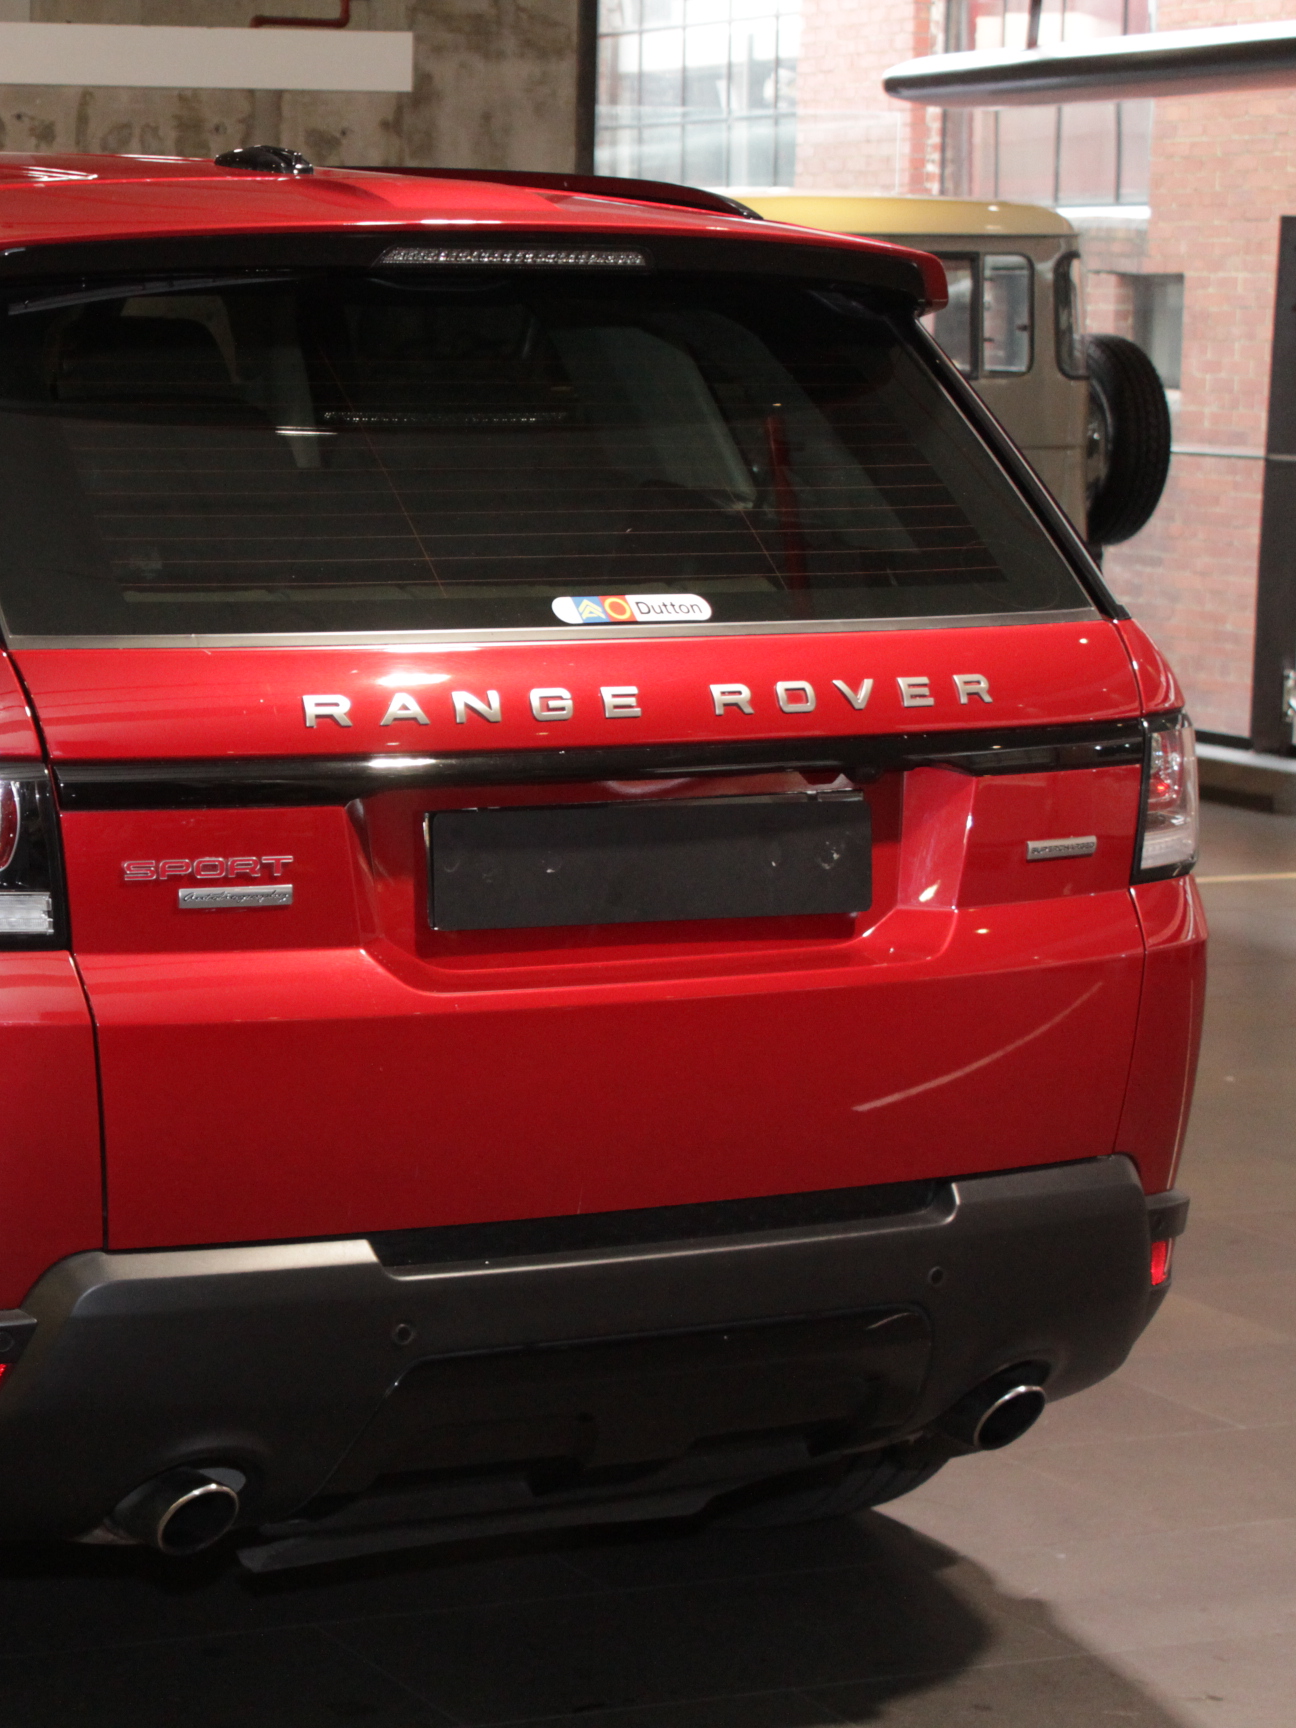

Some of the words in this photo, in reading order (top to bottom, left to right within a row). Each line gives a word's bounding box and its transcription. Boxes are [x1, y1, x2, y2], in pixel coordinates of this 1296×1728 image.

[634, 601, 703, 615] Dutton
[301, 685, 642, 728] RANGE
[709, 673, 994, 716] ROVER
[123, 855, 294, 881] SPORT
